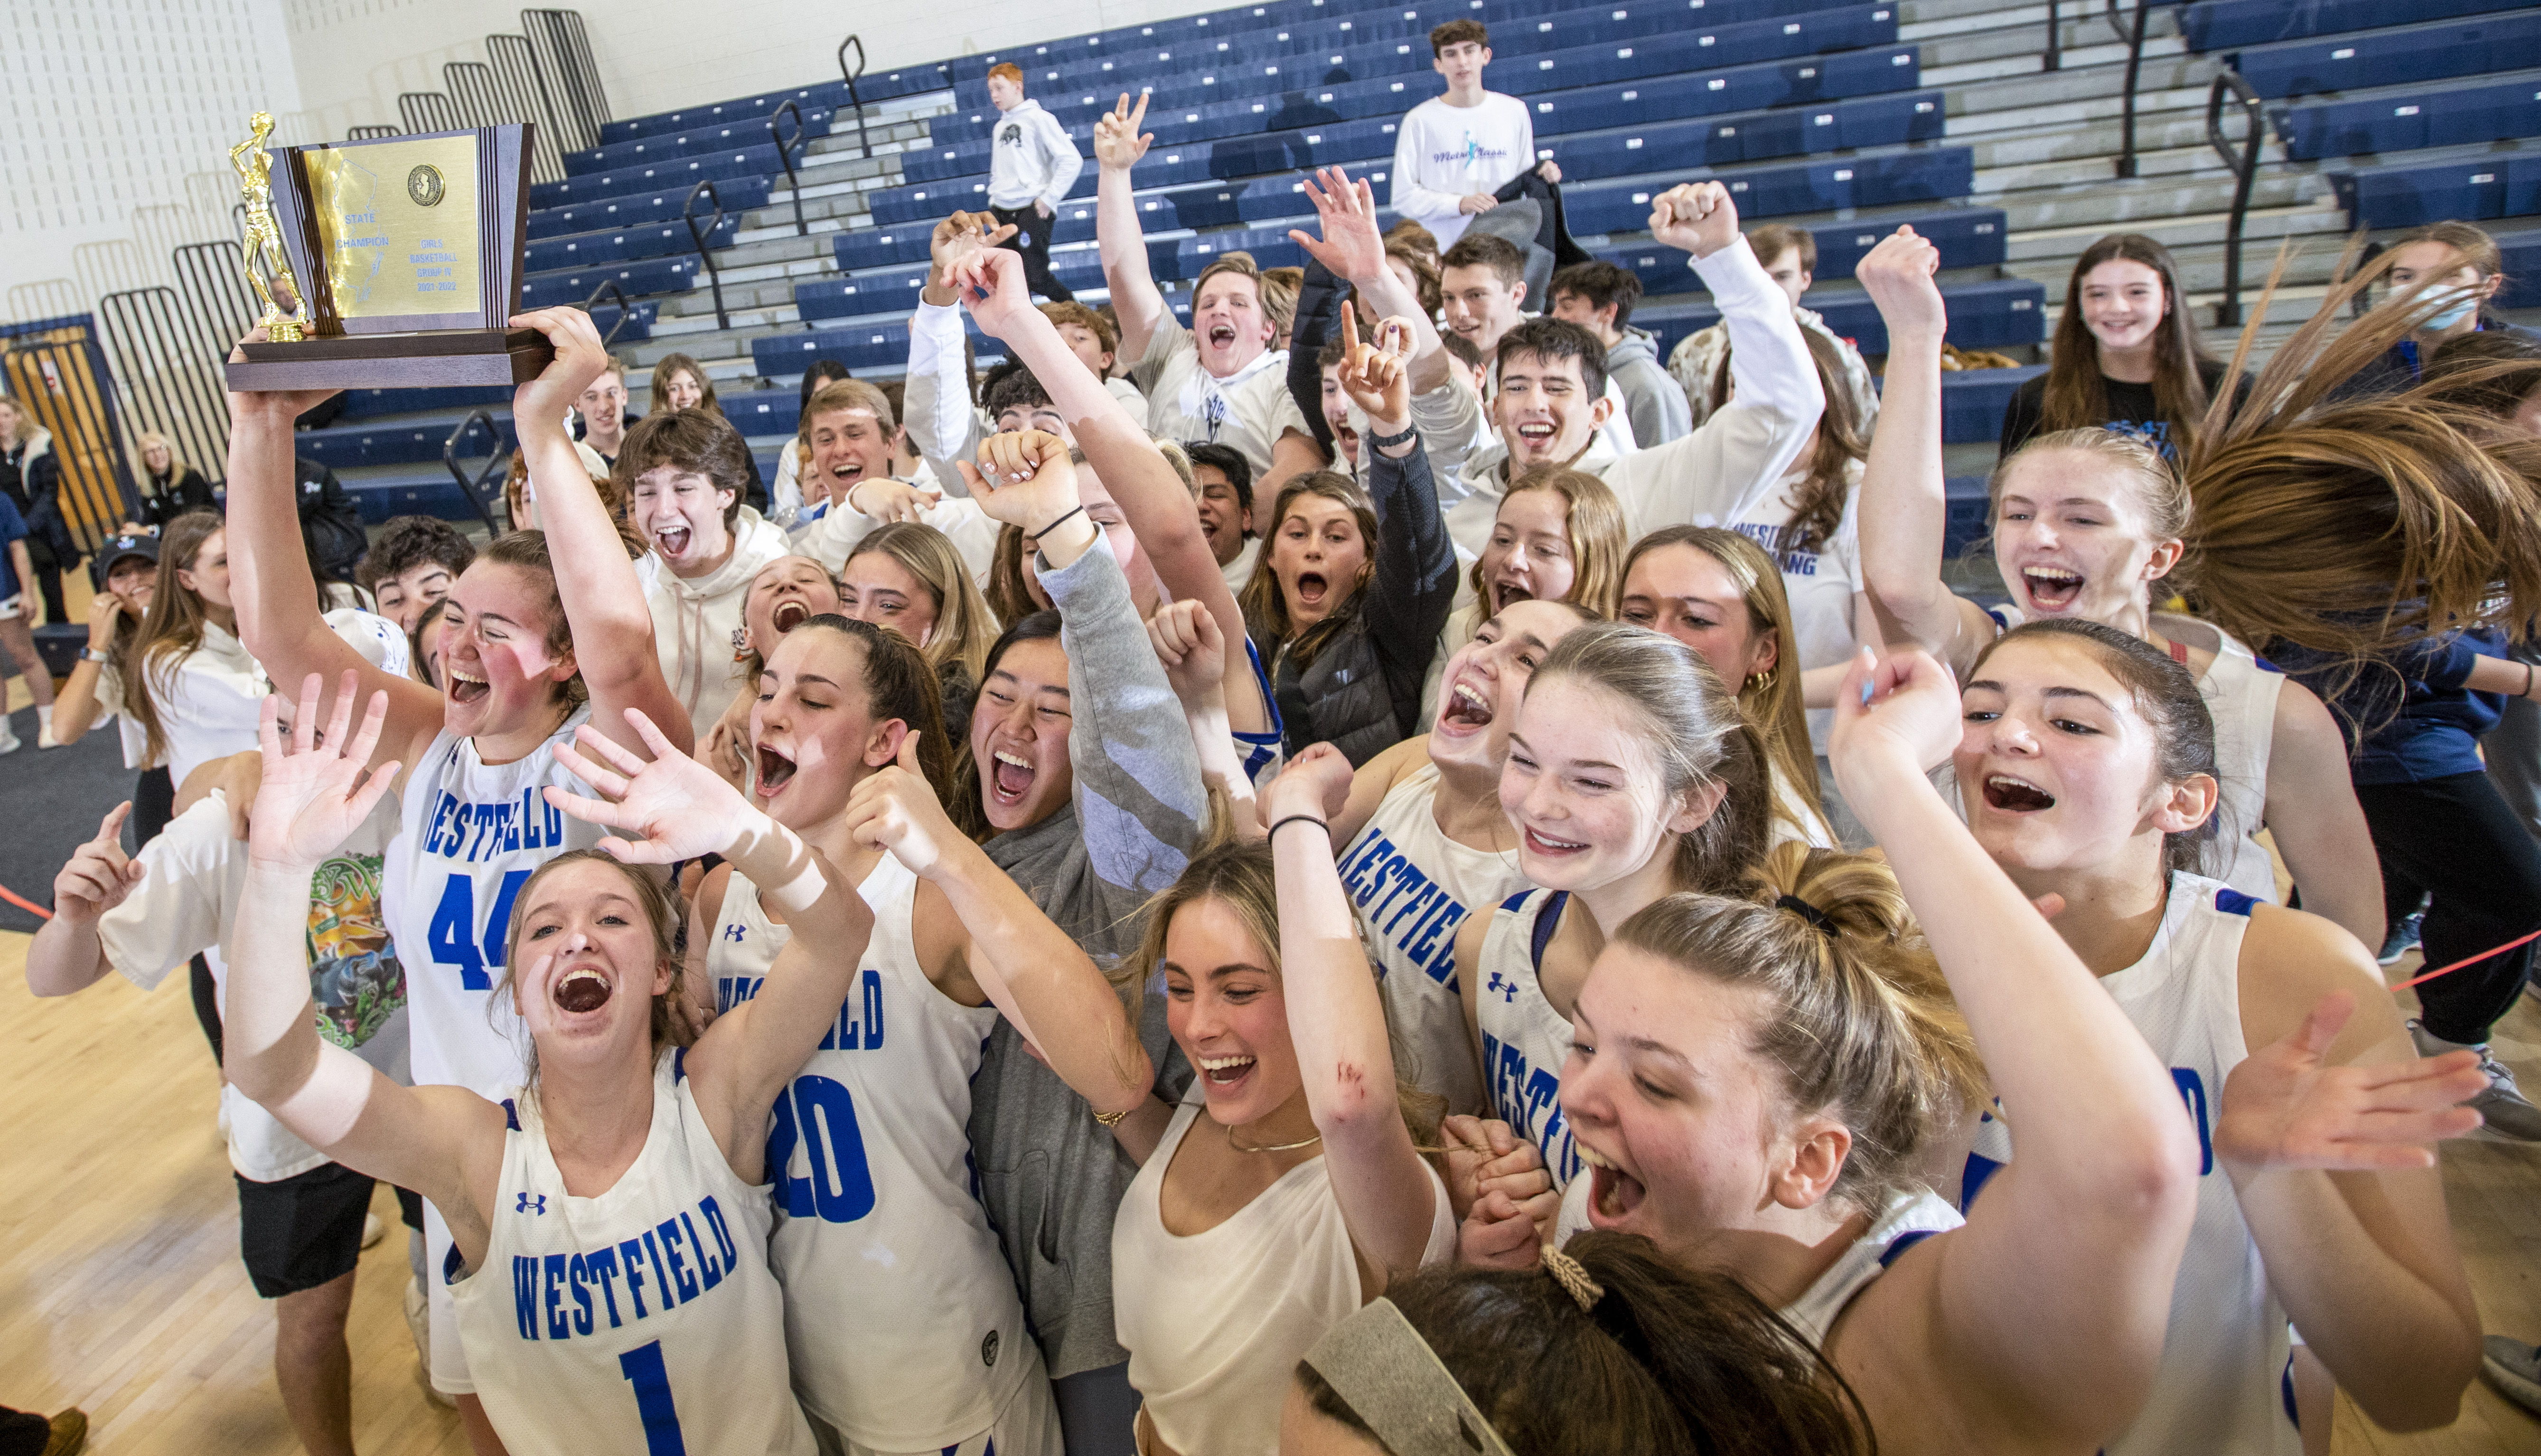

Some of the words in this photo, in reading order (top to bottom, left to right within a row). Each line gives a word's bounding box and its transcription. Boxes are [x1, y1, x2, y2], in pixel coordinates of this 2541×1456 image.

[345, 214, 375, 224] STATE
[336, 237, 389, 248] CHAMPION
[421, 239, 443, 249] GIRLS
[409, 253, 458, 263] BASKETBALL
[417, 268, 442, 277] GROUP
[417, 281, 457, 291] 2021-2022
[763, 1074, 876, 1223] 20
[513, 1195, 737, 1341] WESTFIELD
[619, 1339, 686, 1456] 1
